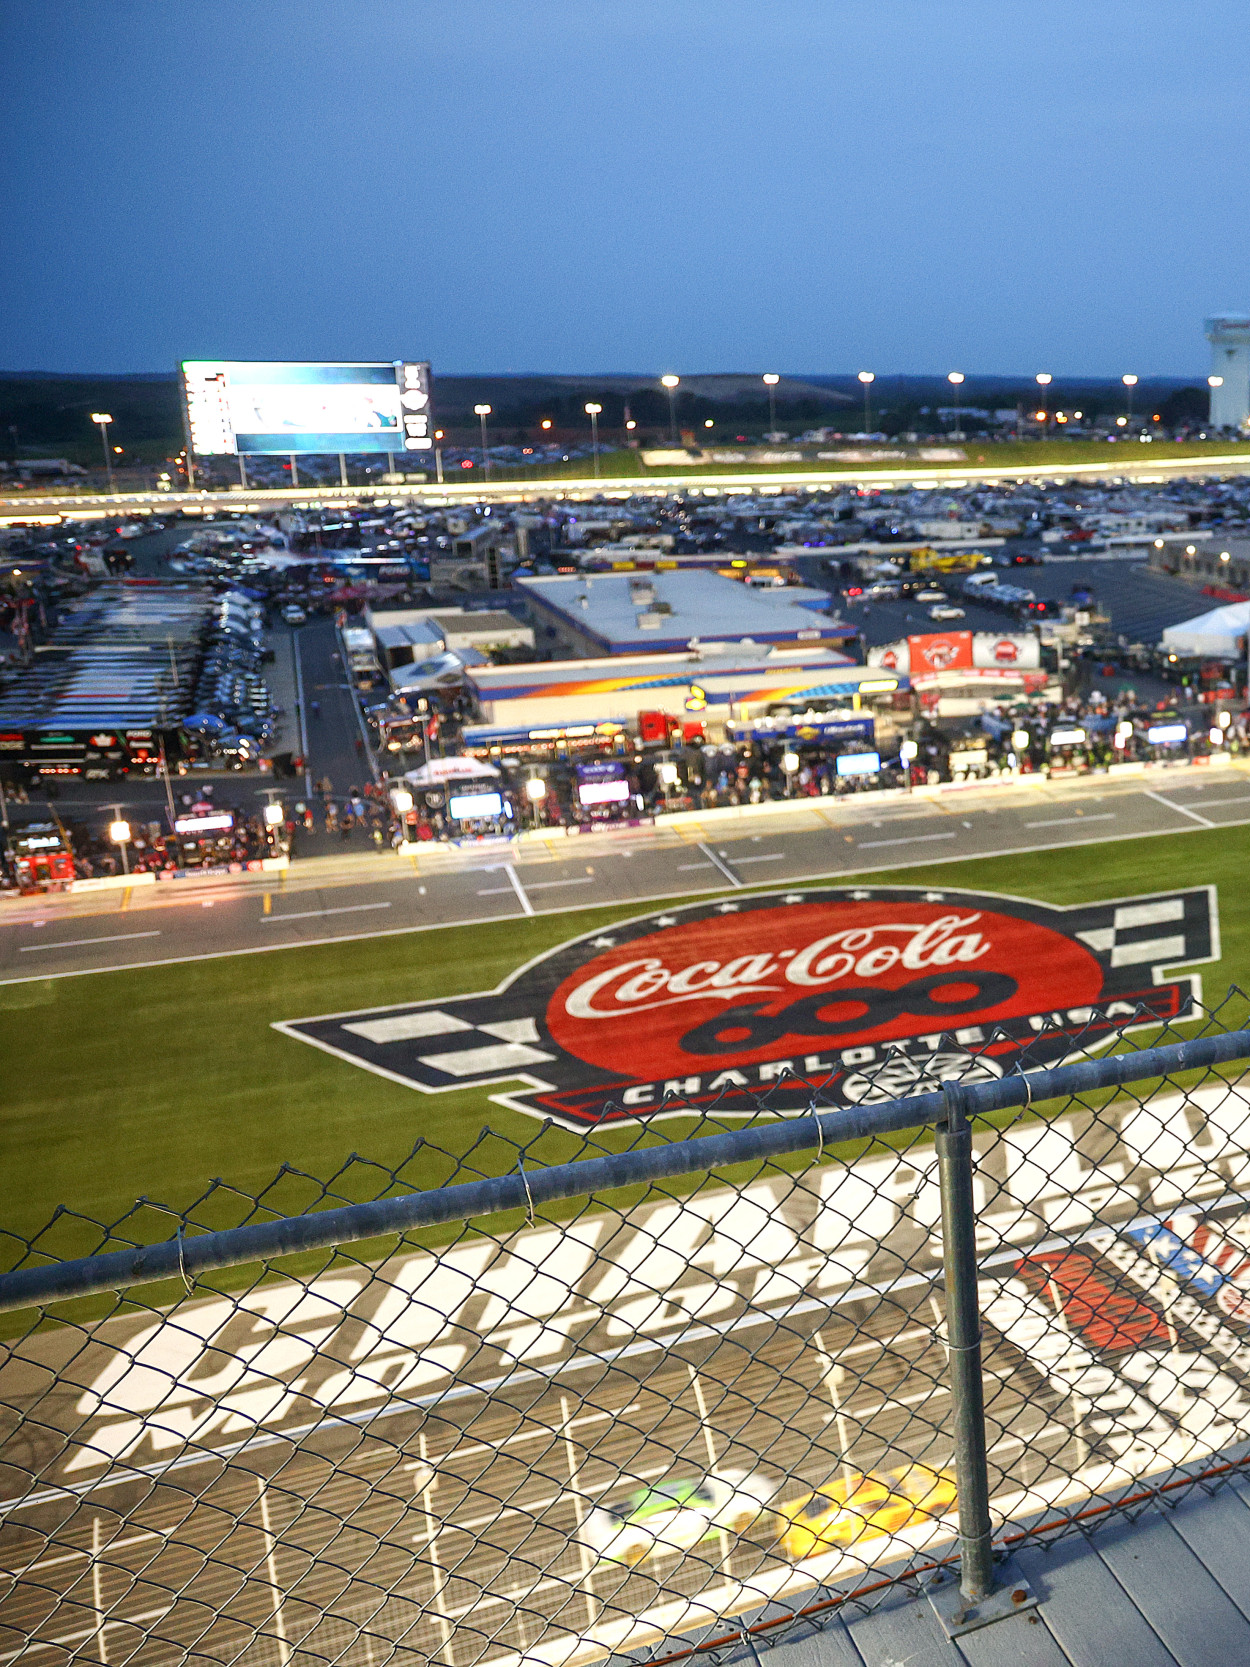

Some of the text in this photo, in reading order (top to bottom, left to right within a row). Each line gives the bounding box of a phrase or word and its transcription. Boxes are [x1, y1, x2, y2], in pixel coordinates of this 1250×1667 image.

[565, 912, 991, 1019] Coca-Cola
[678, 969, 1019, 1055] 600
[1028, 1000, 1138, 1031] USA
[63, 1248, 871, 1474] MOTOR
